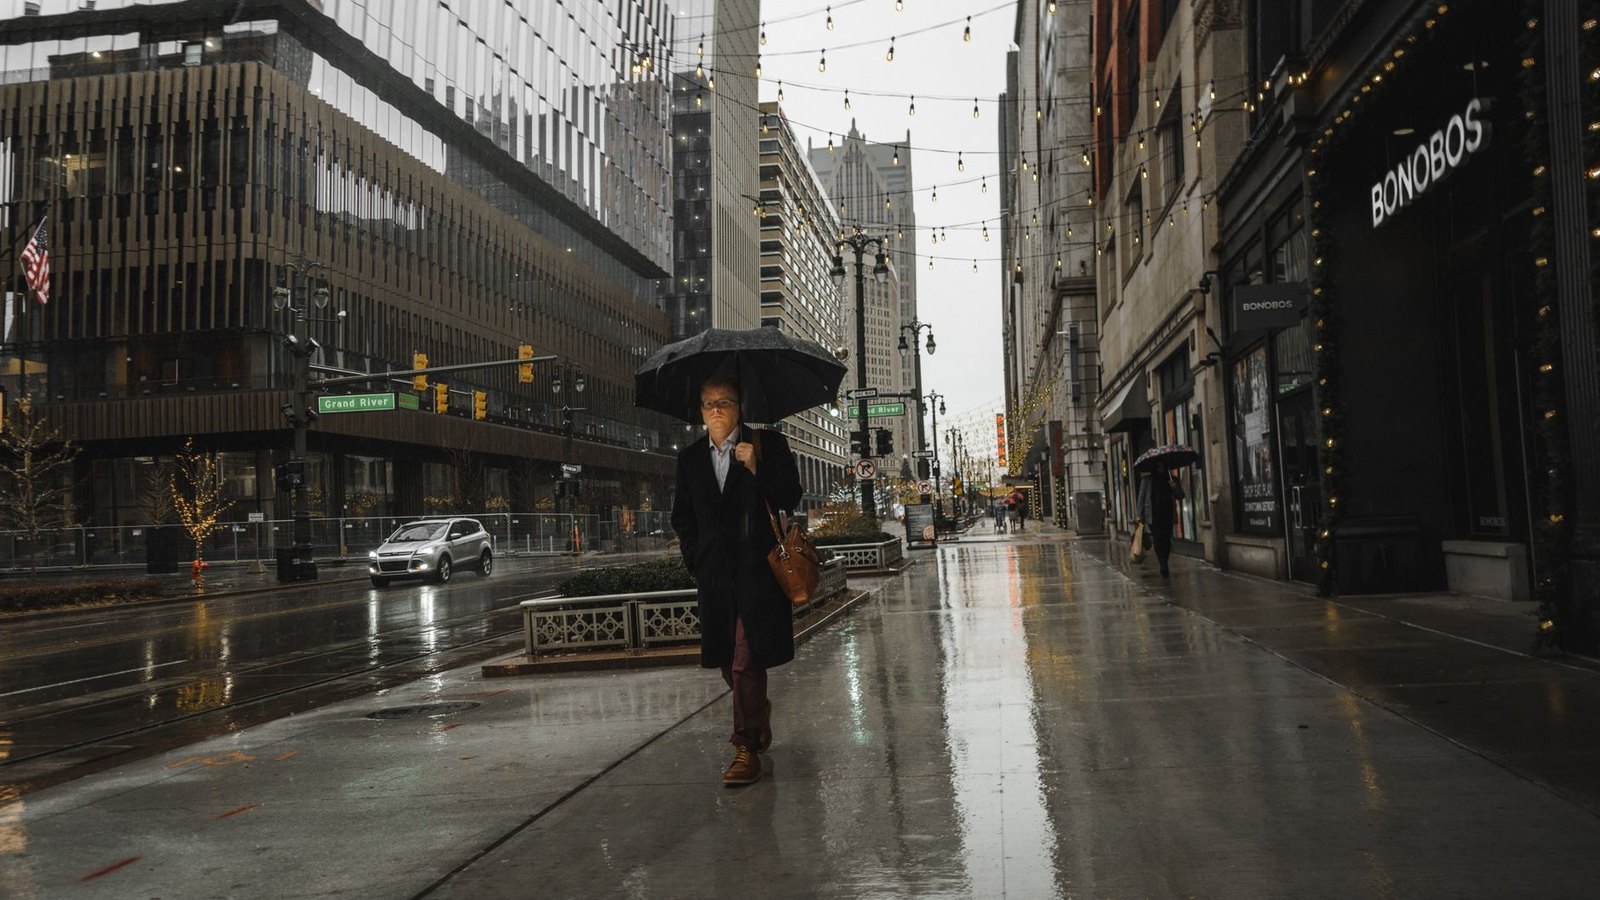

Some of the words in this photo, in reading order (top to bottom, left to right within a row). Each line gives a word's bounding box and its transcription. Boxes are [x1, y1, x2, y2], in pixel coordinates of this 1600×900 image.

[1371, 98, 1482, 228] BONOBOS
[1243, 300, 1293, 311] BONOBOS
[324, 399, 355, 409] Grand
[360, 398, 388, 407] River
[852, 407, 875, 415] Gnd
[878, 406, 899, 414] River
